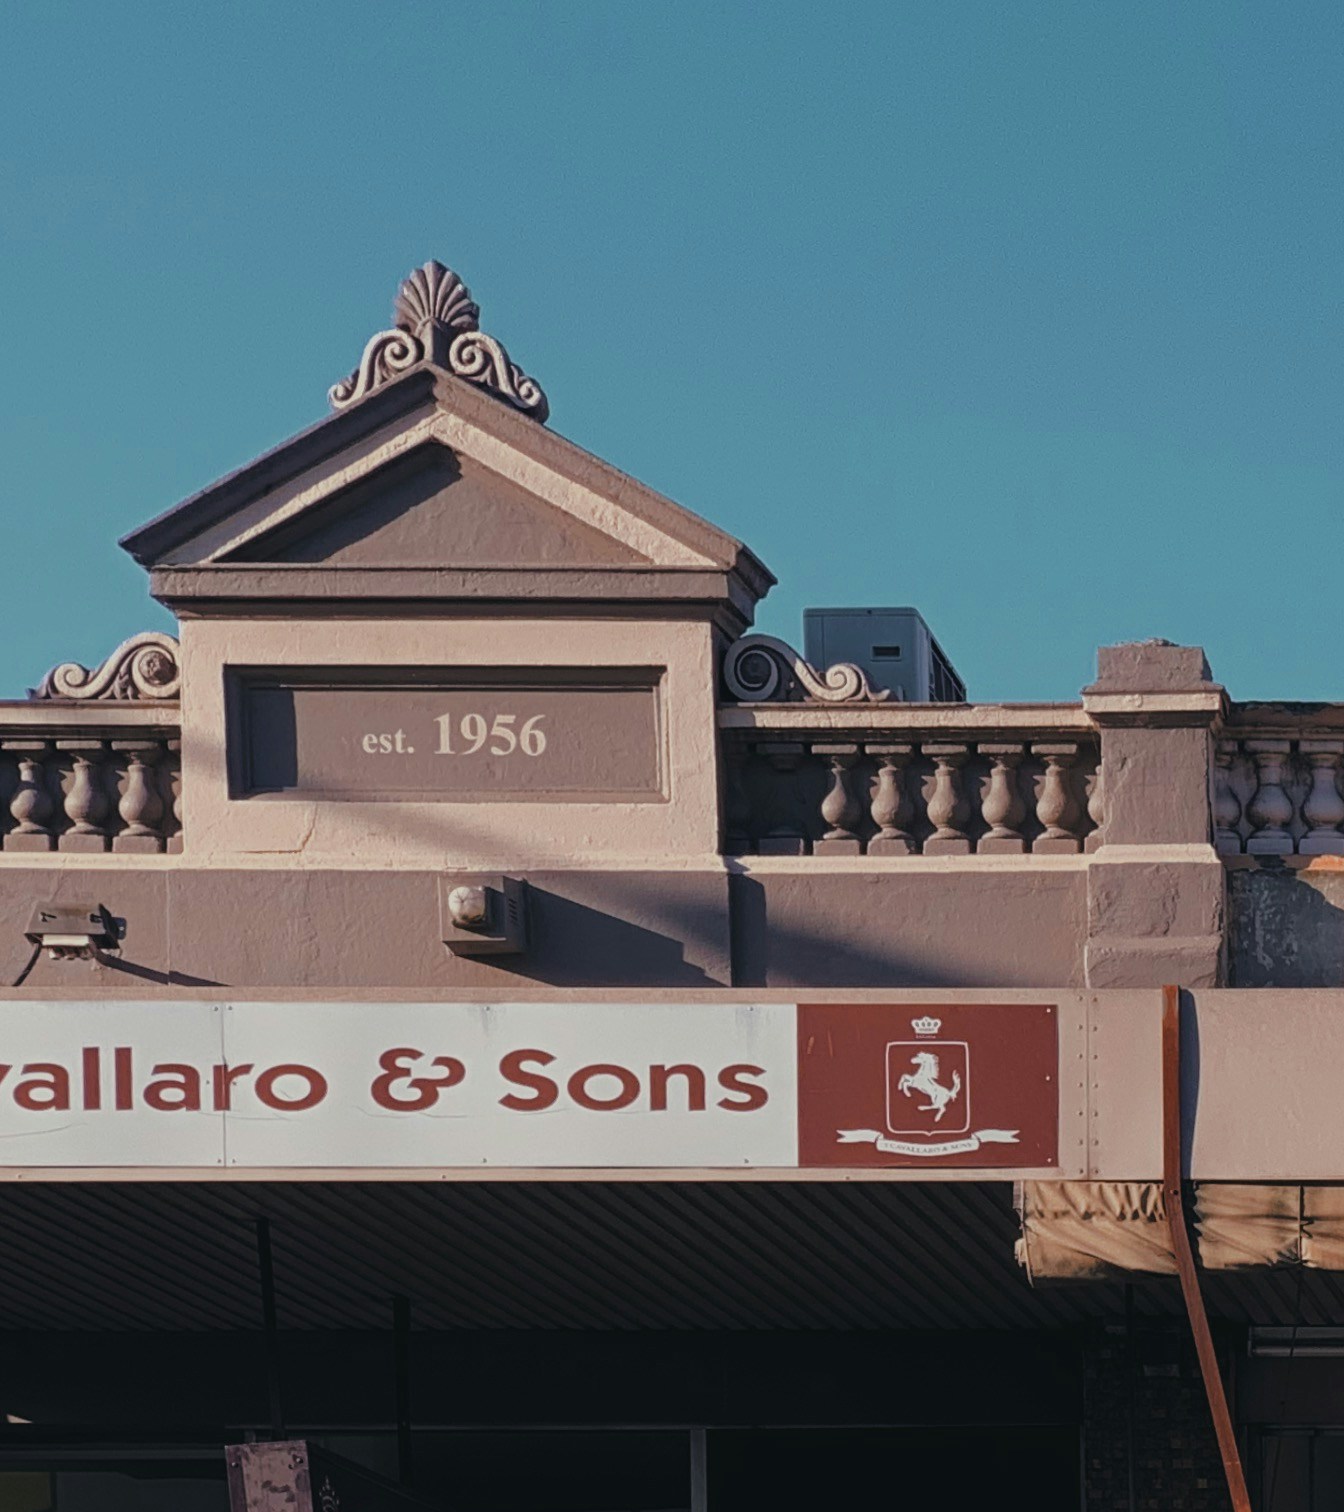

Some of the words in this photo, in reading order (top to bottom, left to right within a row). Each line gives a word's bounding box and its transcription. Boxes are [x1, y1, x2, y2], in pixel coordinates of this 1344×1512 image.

[362, 728, 415, 754] est.
[433, 712, 547, 757] 1956
[371, 1047, 466, 1113] &
[497, 1048, 769, 1113] Sons
